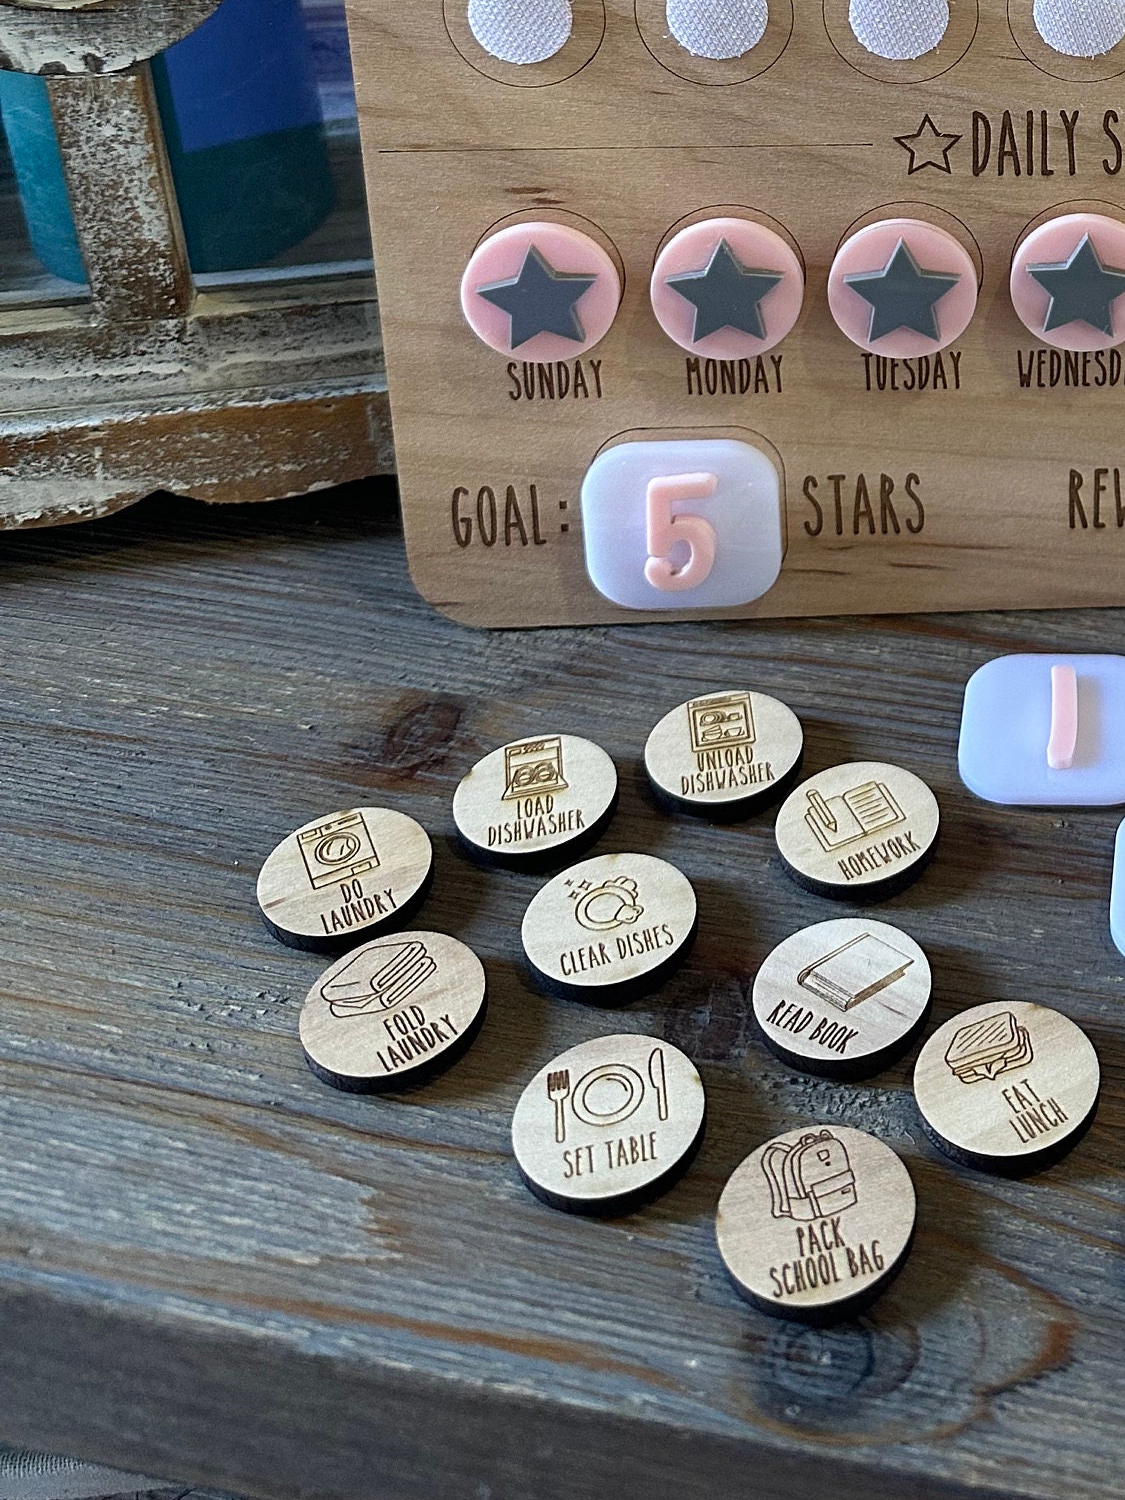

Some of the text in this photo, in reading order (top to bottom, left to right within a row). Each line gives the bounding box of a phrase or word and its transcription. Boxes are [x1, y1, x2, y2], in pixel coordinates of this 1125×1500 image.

[972, 110, 1079, 177] DAILY
[507, 360, 604, 400] SUNDAY
[686, 355, 783, 396] MONDAY
[861, 351, 962, 392] TUESDAY
[451, 471, 925, 593] GOAL: 5 STARS
[1045, 664, 1078, 770] 1
[681, 762, 776, 796] DISHWASHER
[696, 745, 754, 771] UNLOAD
[487, 809, 586, 847] DISHWASHER
[516, 795, 554, 821] LOAD
[837, 831, 922, 881] HOMEWORK
[320, 887, 399, 936] LAUNDRY
[339, 878, 364, 905] DO
[559, 924, 675, 978] CLEAR DISHES
[376, 1013, 459, 1073] LAUNDRY
[383, 1004, 427, 1041] FOLD
[766, 999, 860, 1056] READ BOOK
[1001, 1077, 1043, 1116] EAT
[1008, 1096, 1070, 1145] LUNCH
[563, 1131, 658, 1179] SET TABLE
[796, 1216, 846, 1257] PACK
[769, 1239, 885, 1299] SCHOOL BAG
